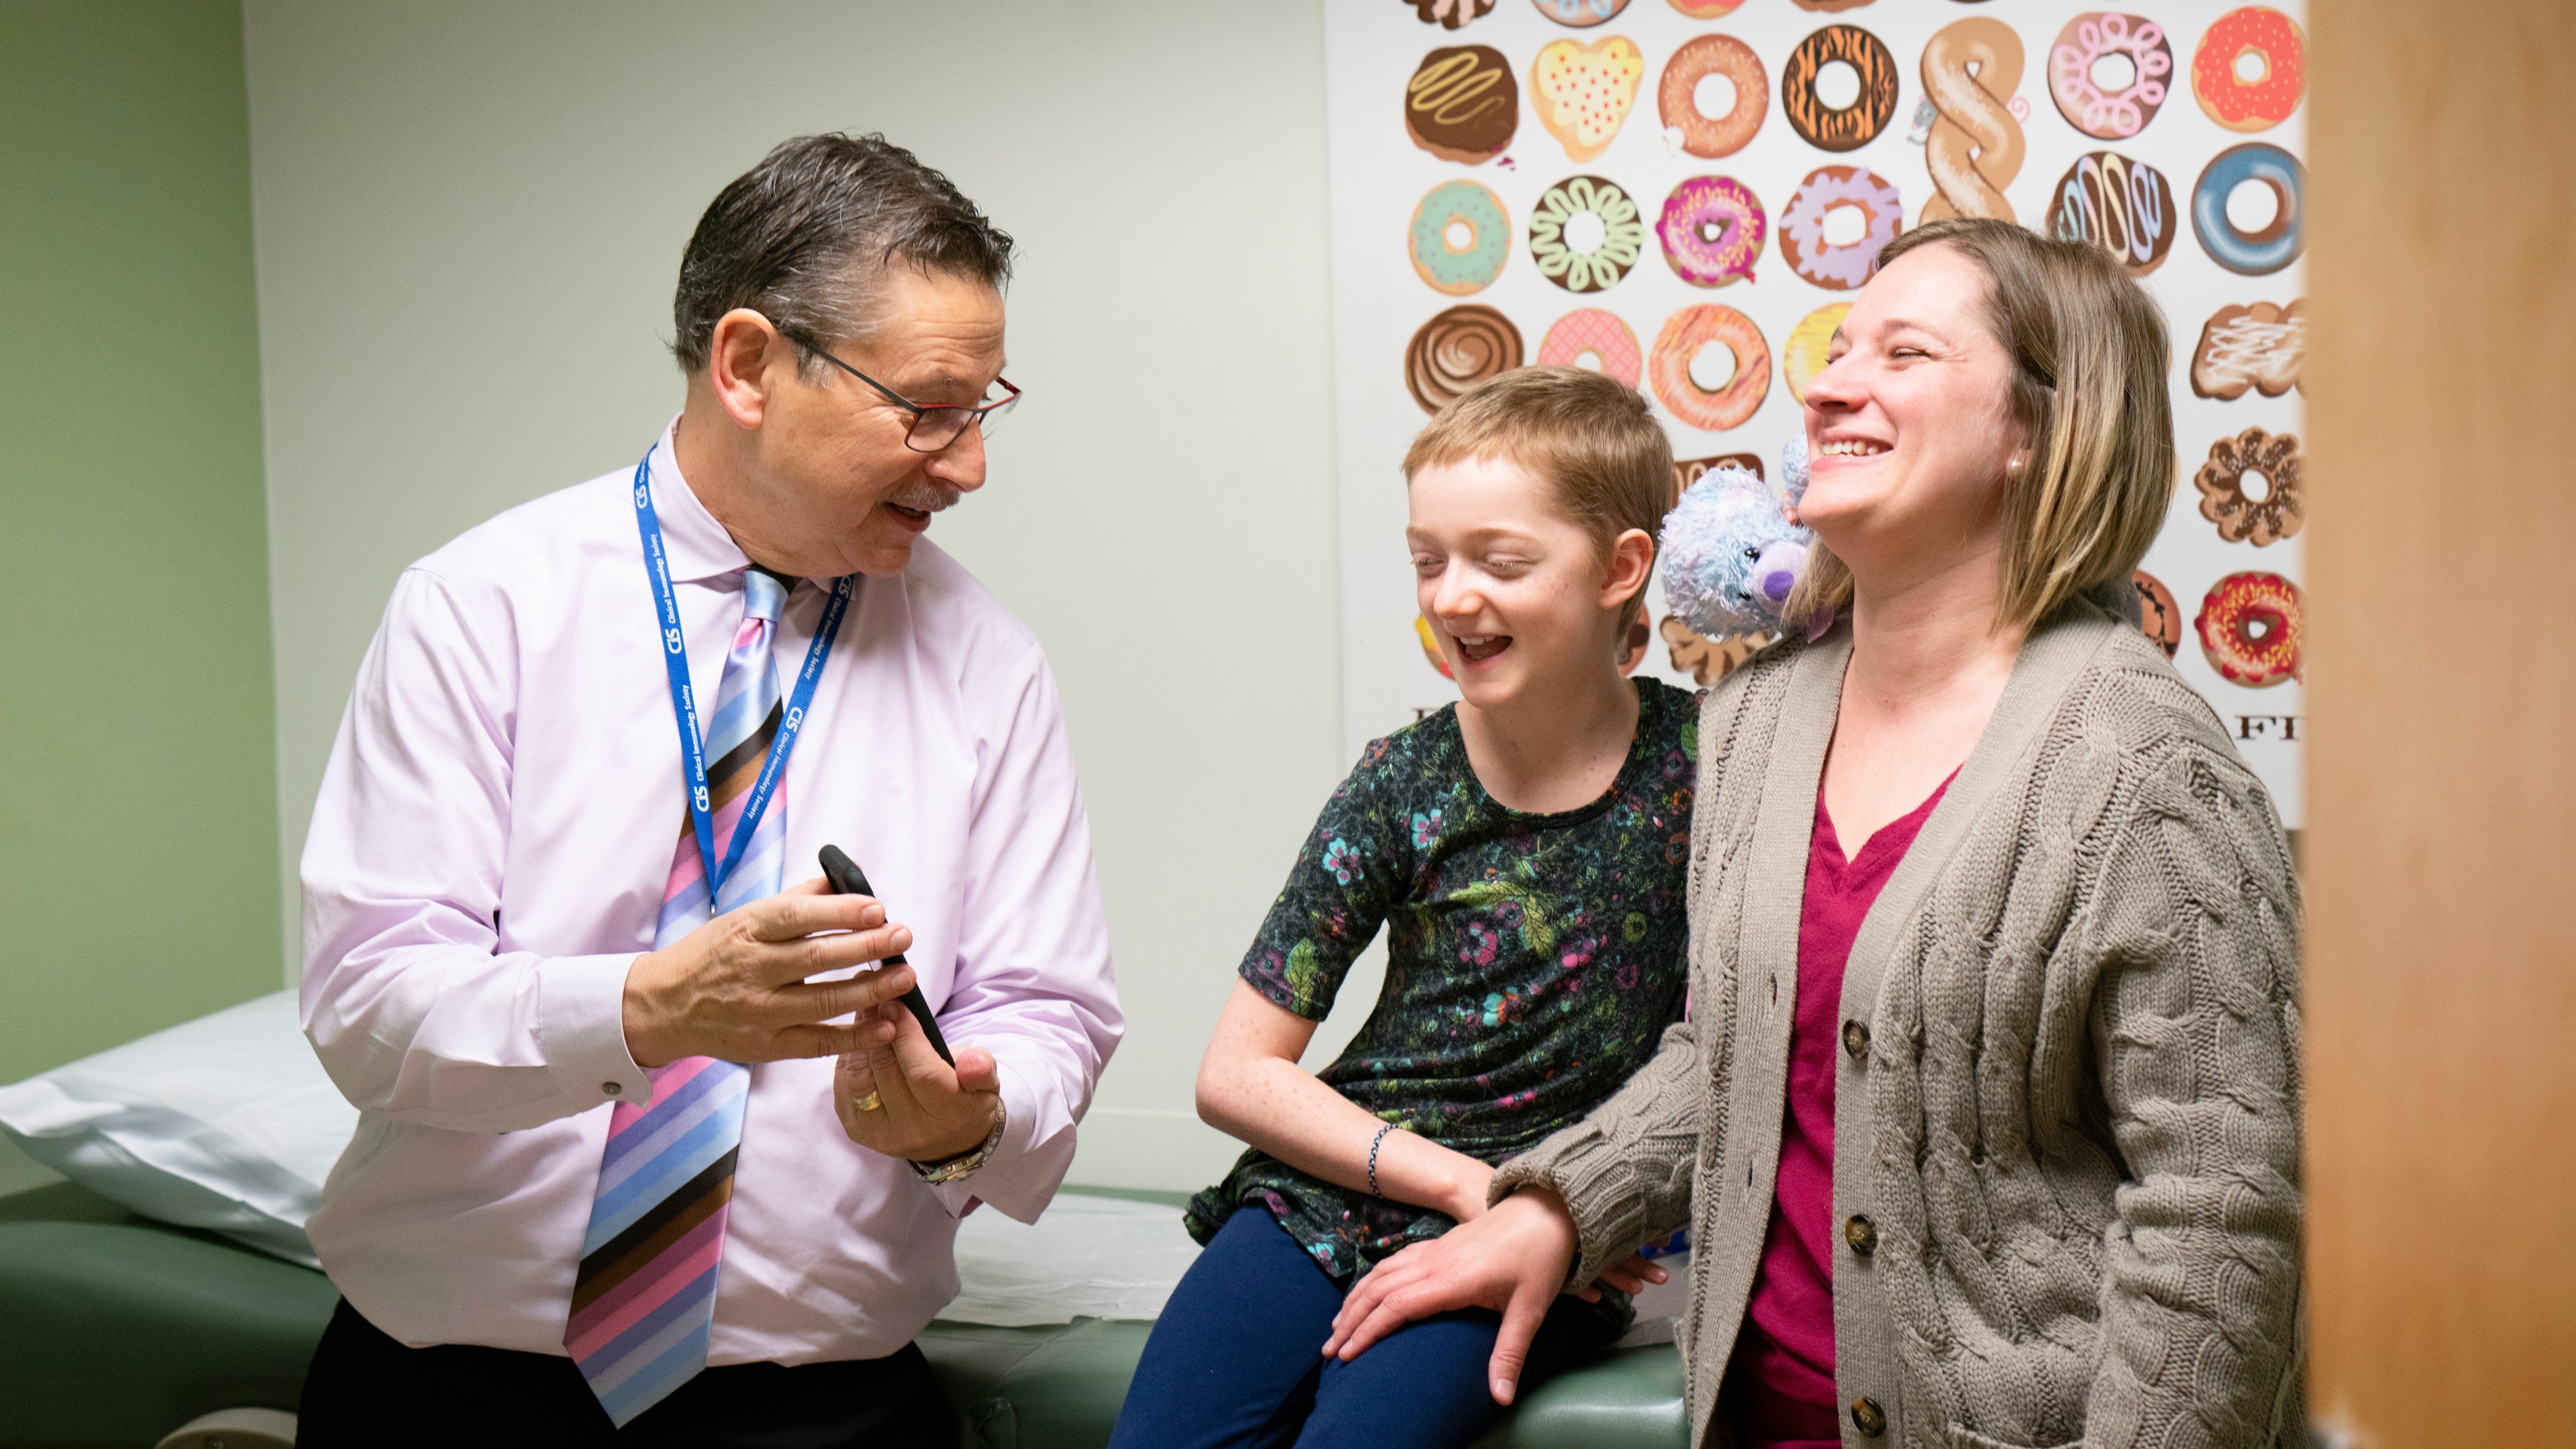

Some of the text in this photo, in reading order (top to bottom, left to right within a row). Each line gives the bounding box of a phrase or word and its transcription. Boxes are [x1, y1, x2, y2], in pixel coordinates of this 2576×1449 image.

[2234, 714, 2305, 741] FI
[777, 732, 790, 755] Clinical
[759, 755, 780, 795] Immunology
[747, 794, 764, 819] Society
